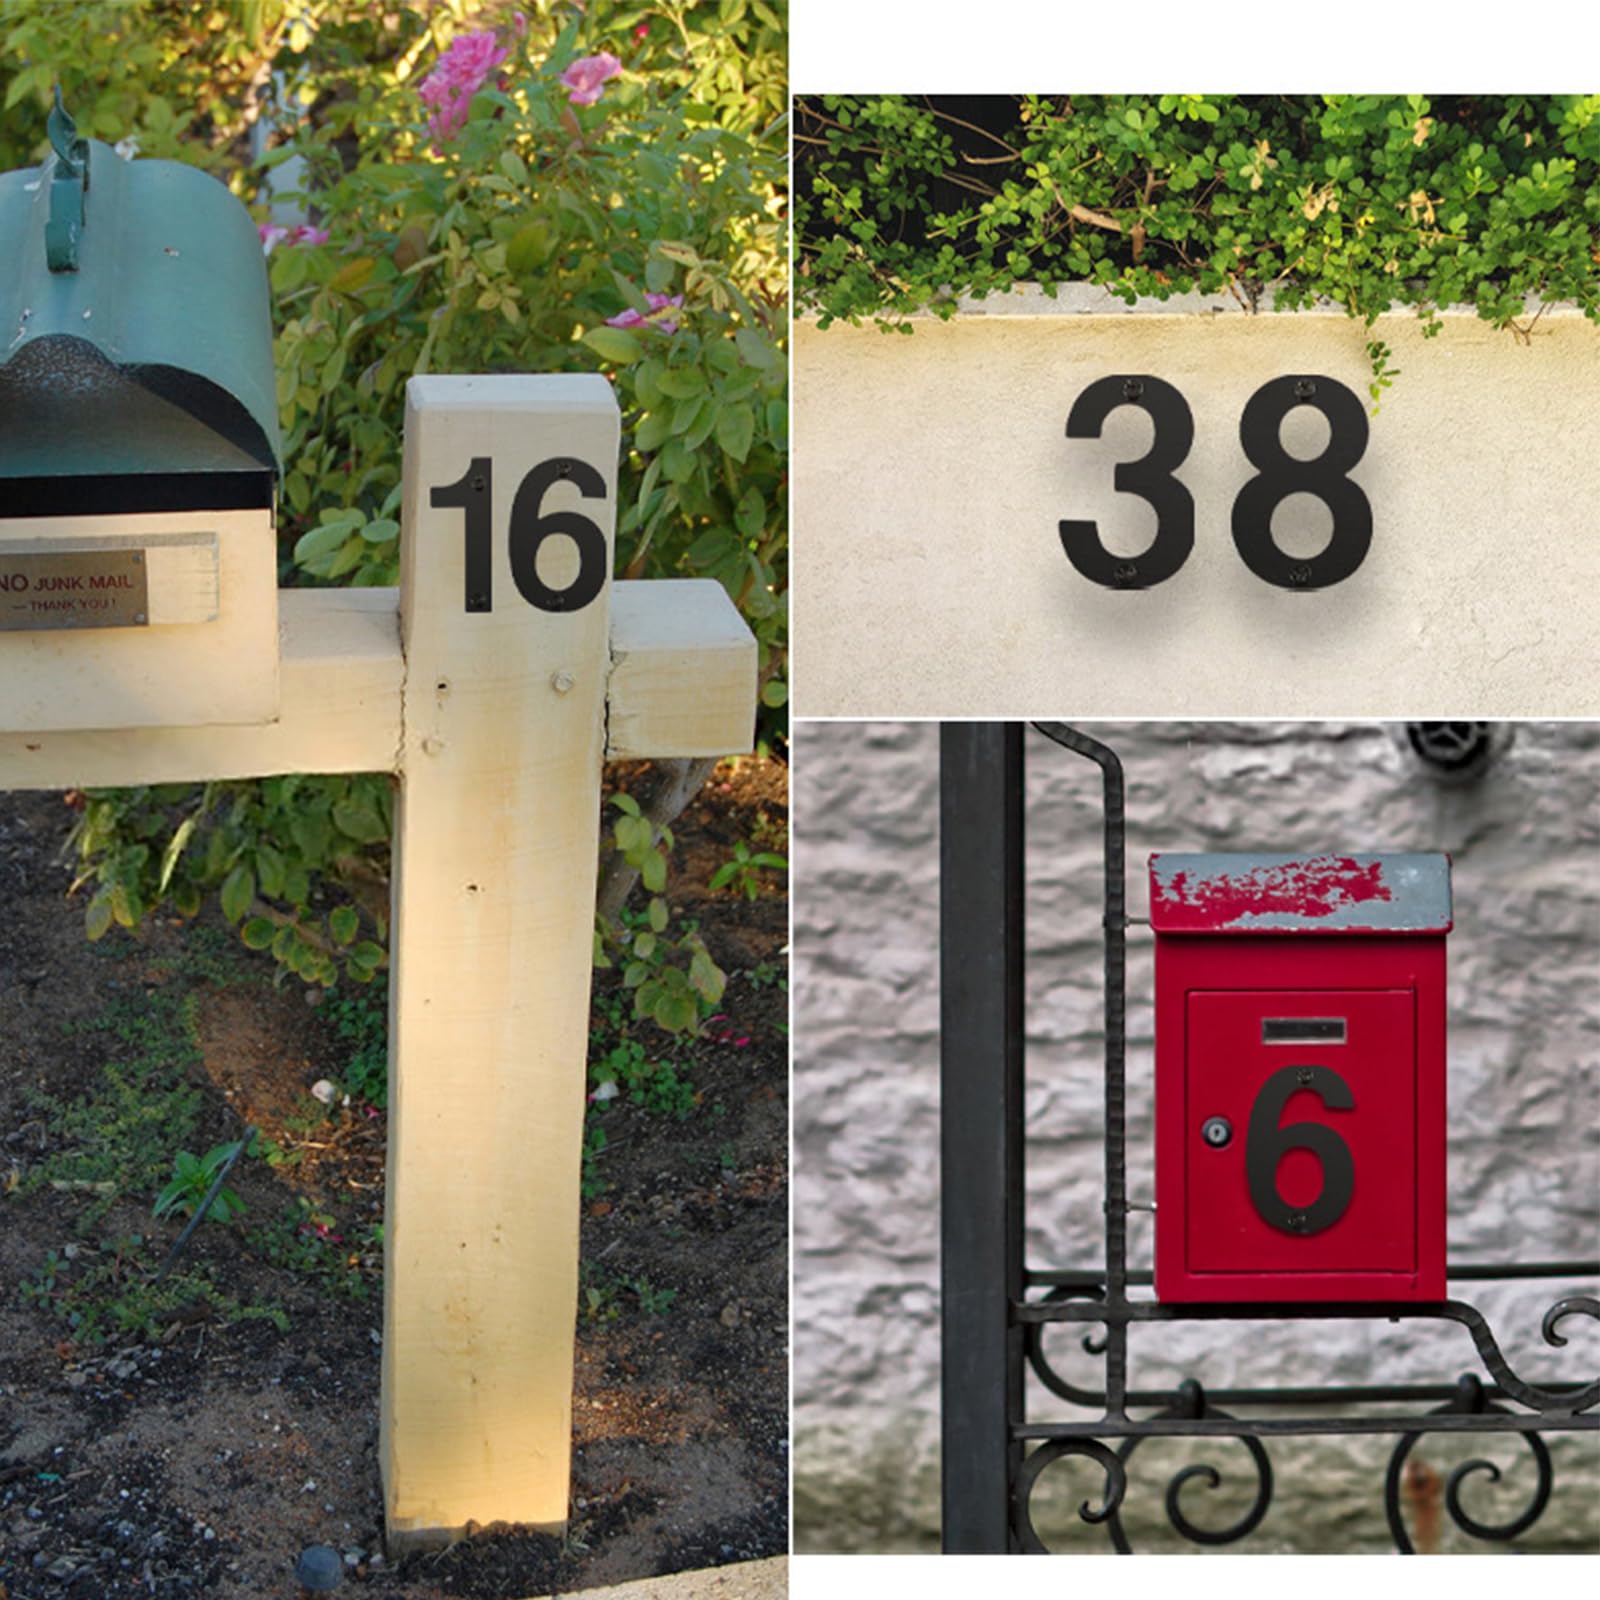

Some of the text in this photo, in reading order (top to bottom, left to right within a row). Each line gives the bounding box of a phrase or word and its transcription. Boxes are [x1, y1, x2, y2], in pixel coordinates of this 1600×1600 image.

[430, 456, 607, 613] 16
[1058, 373, 1374, 590] 38
[34, 576, 84, 592] JUNK
[89, 575, 134, 590] MAIL
[1245, 1064, 1356, 1237] 6
